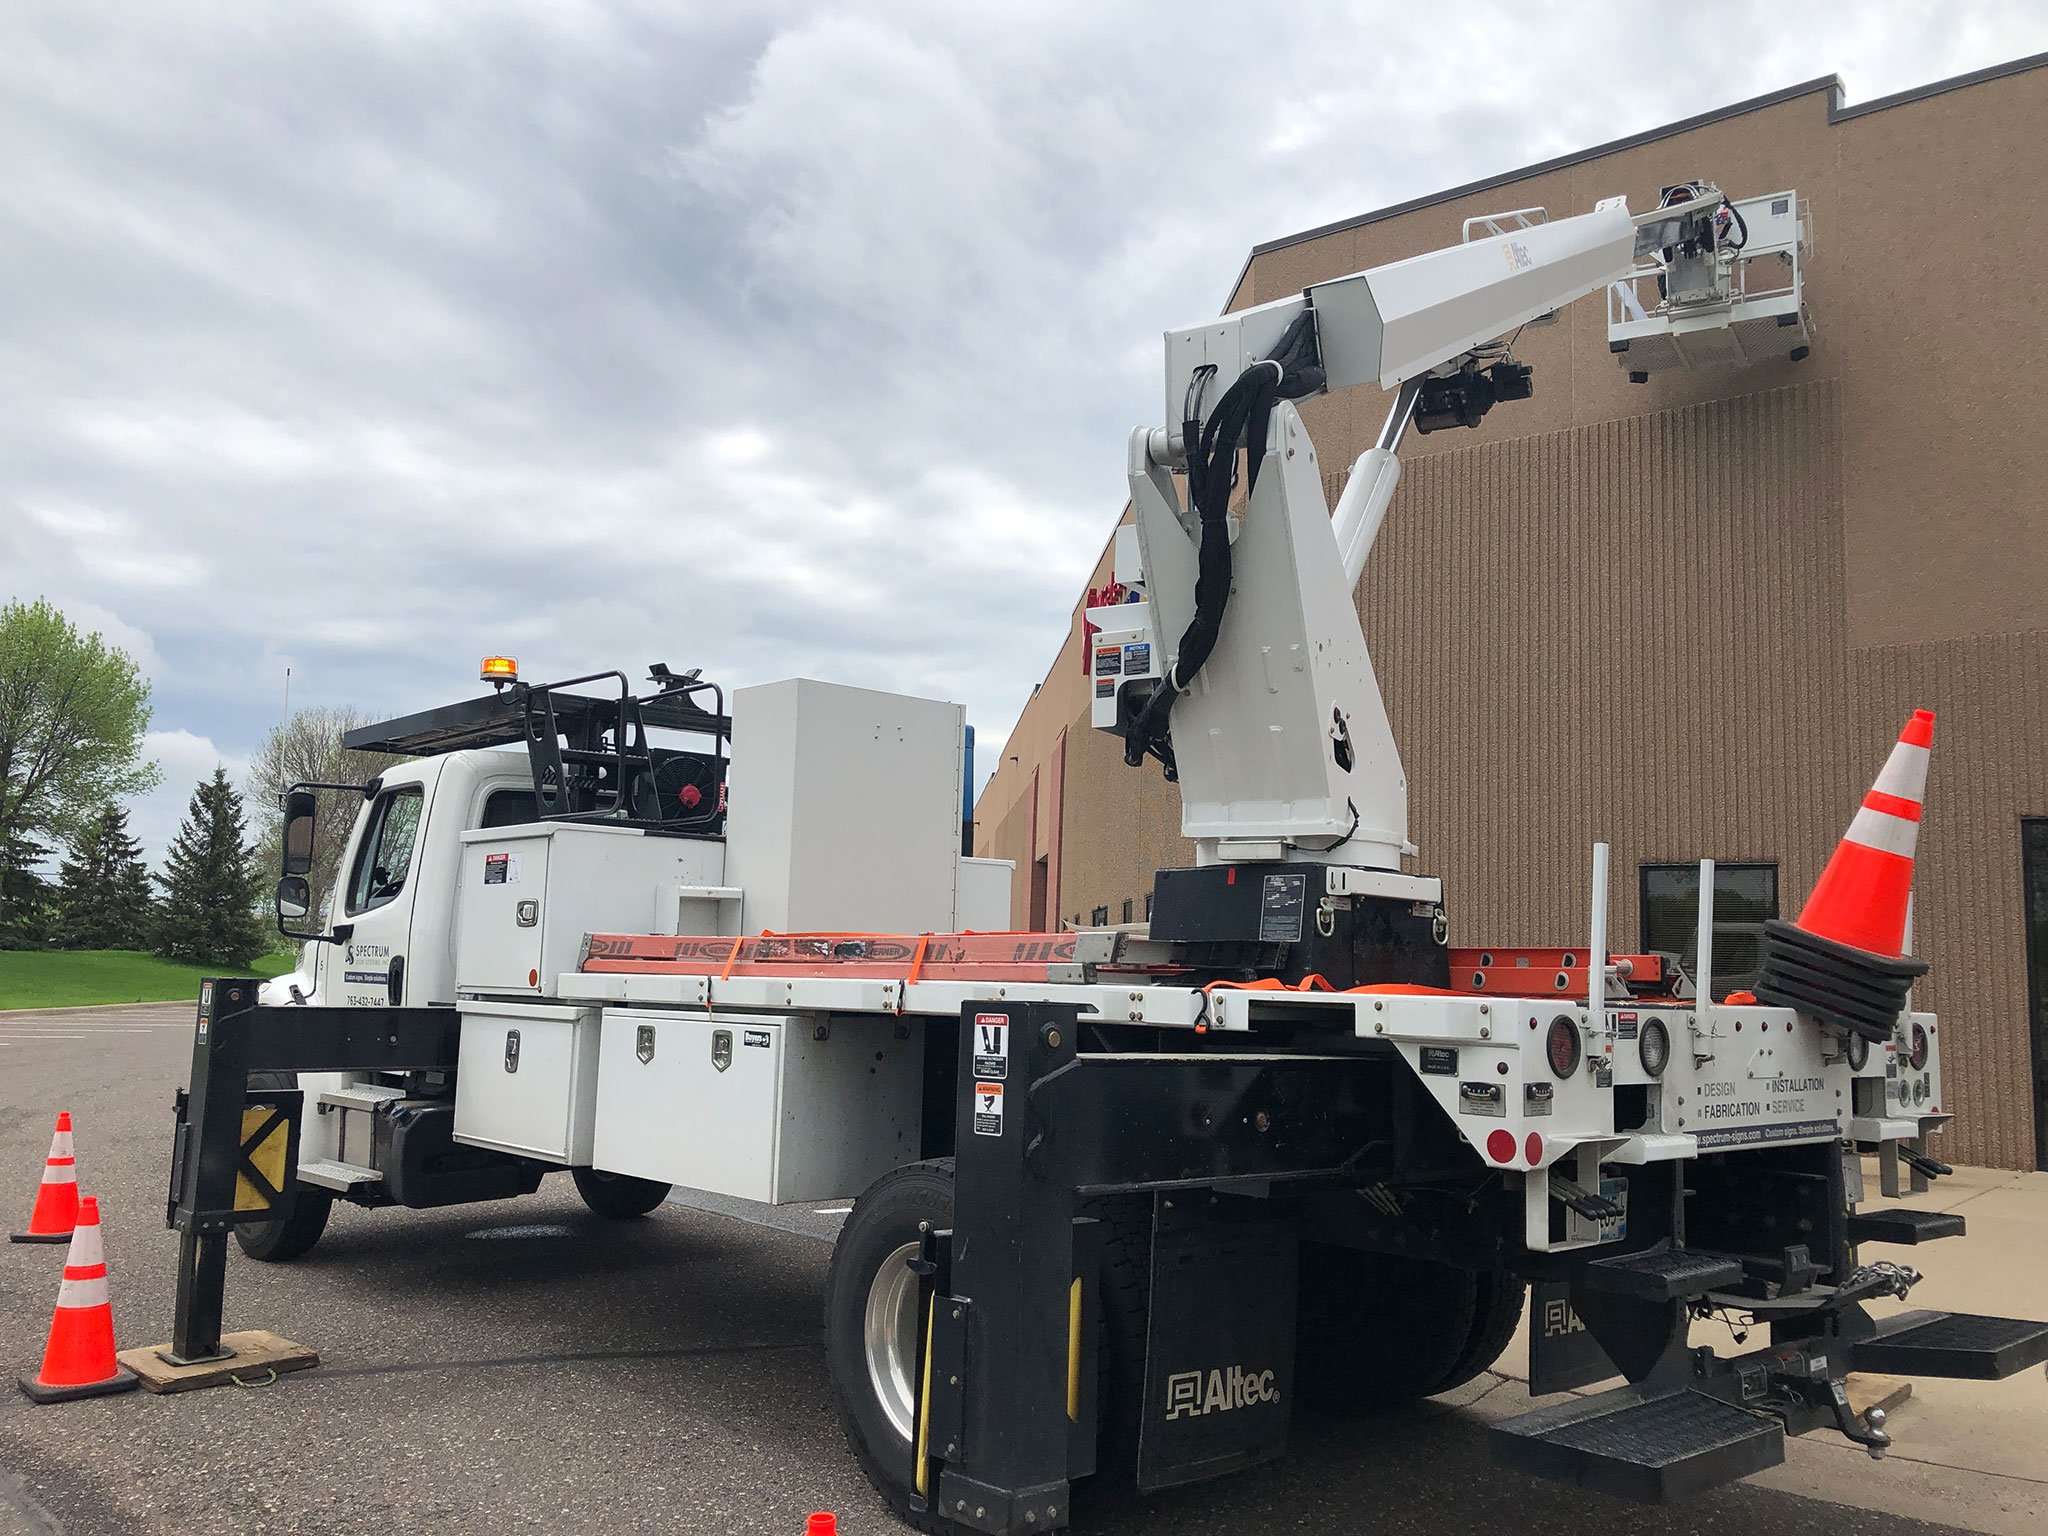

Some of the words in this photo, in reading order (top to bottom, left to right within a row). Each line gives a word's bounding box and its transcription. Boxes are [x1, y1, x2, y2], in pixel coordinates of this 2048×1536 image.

[356, 945, 389, 957] SPECTRUM
[985, 1016, 1005, 1024] DANGER
[1704, 1082, 1736, 1097] DESIGN
[1772, 1078, 1824, 1093] INSTALLATION
[1704, 1102, 1760, 1119] FABRICATION
[1772, 1099, 1805, 1114] SERVICE
[1765, 1128, 1784, 1138] Custom
[1798, 1125, 1814, 1136] Simple
